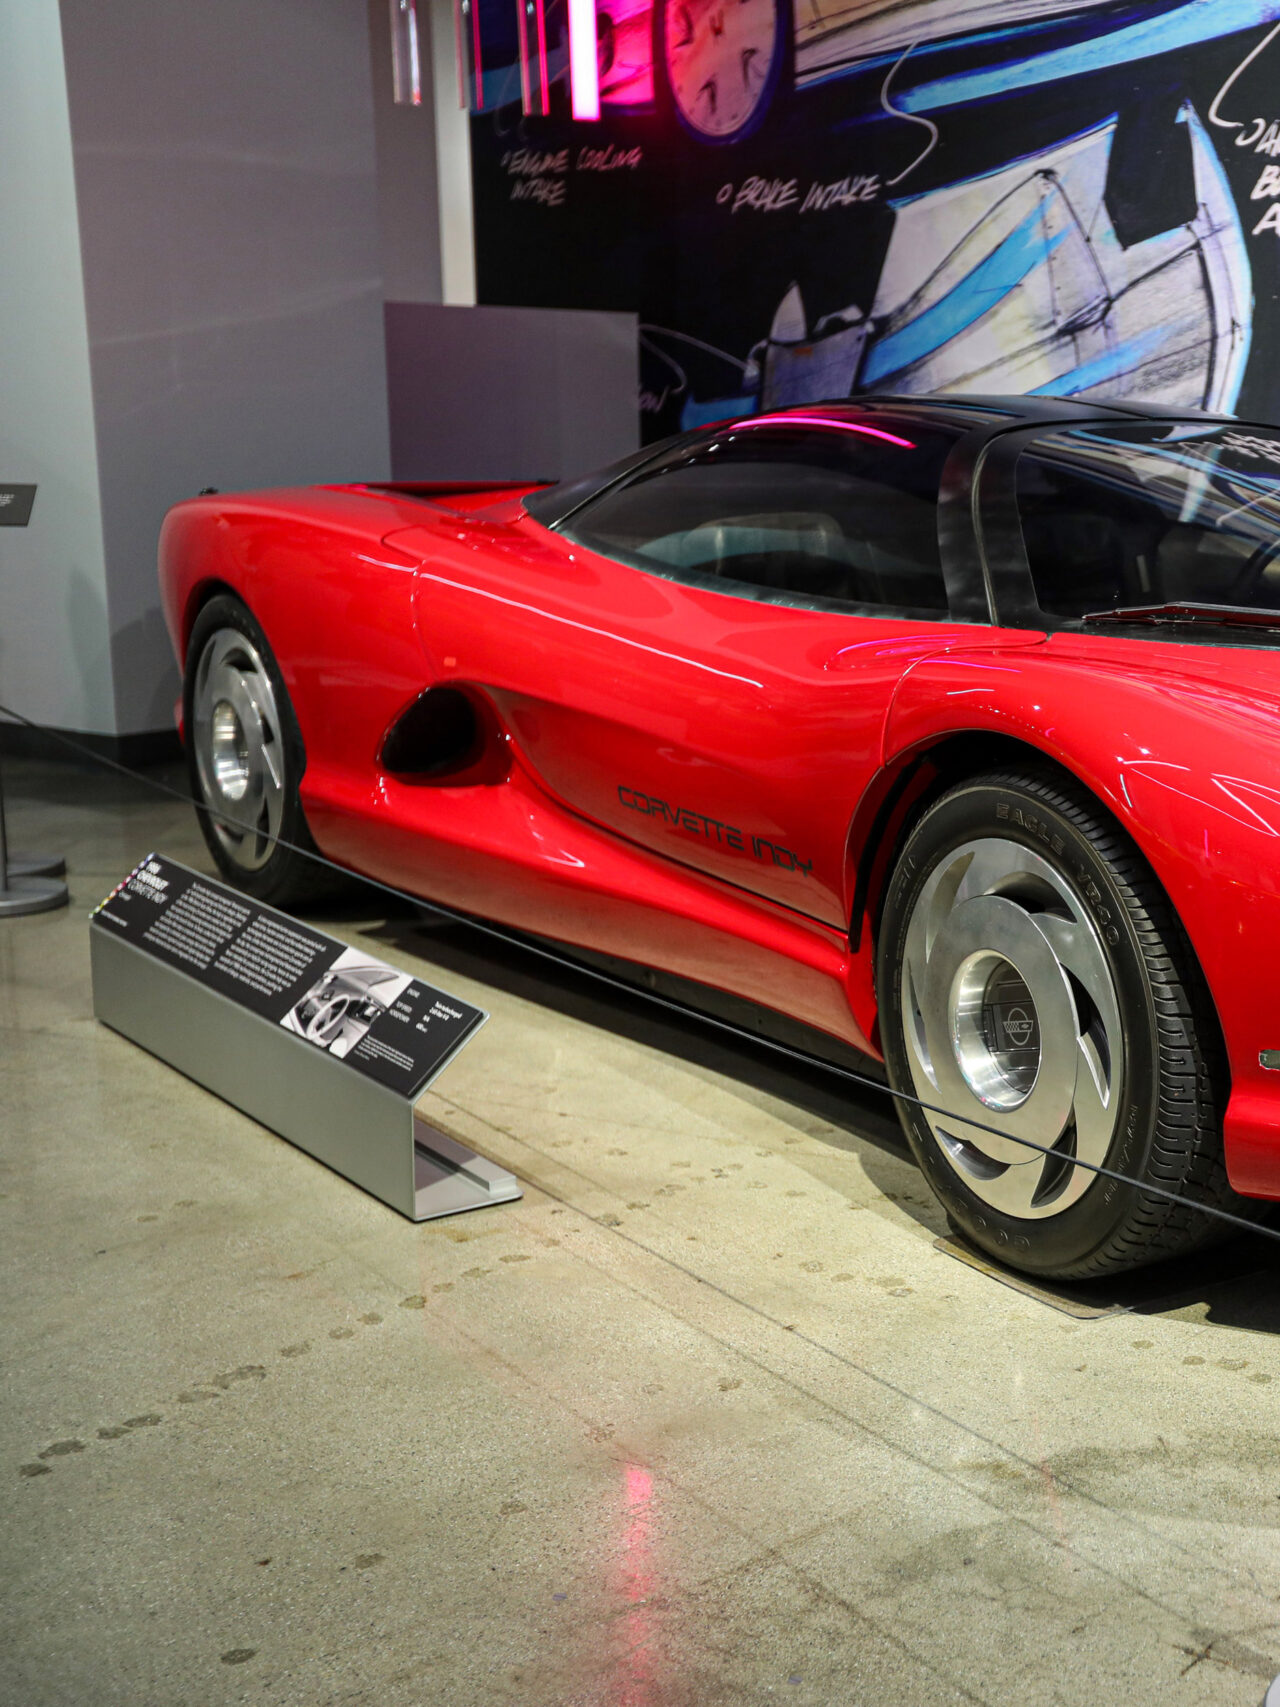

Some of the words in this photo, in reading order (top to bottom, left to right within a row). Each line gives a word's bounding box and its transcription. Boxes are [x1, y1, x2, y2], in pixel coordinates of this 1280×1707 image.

[507, 148, 569, 176] ENGINE
[576, 143, 643, 172] COOLING
[510, 179, 567, 206] INTAKE
[732, 175, 800, 214] BRAKE
[800, 174, 881, 214] INTAKE
[617, 784, 746, 850] CORVETTE
[751, 835, 813, 877] INDY
[995, 802, 1067, 856] EAGLE
